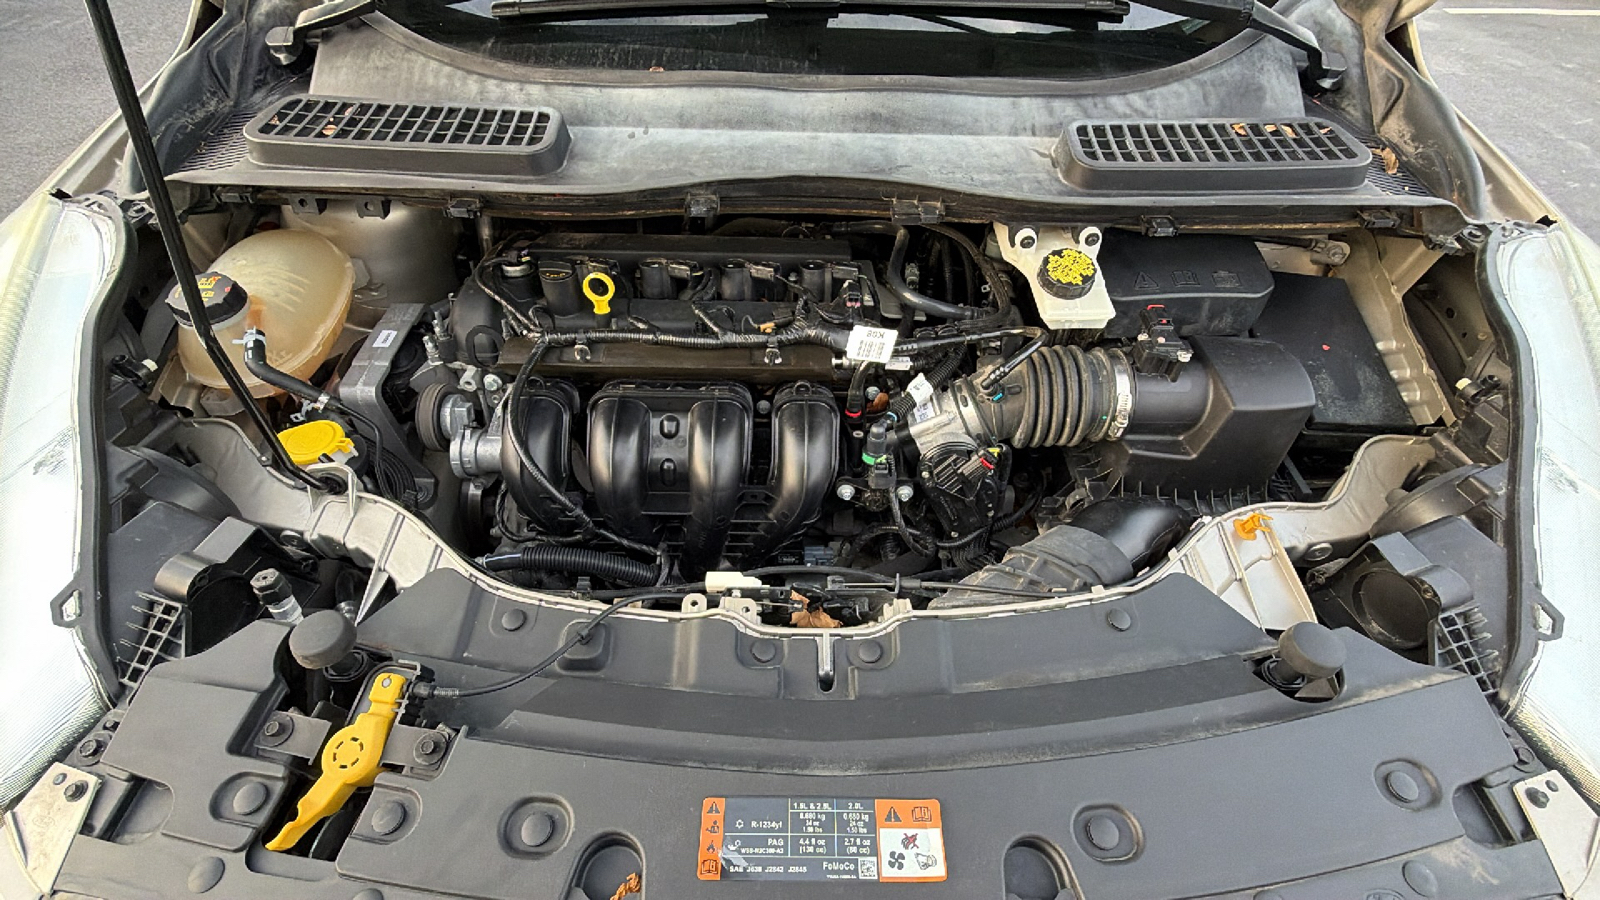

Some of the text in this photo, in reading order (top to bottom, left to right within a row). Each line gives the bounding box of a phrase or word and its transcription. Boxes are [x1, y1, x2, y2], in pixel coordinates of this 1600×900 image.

[861, 813, 869, 822] kg
[767, 838, 784, 846] PAG
[844, 838, 854, 846] 2.7
[822, 861, 855, 870] FoMoCo
